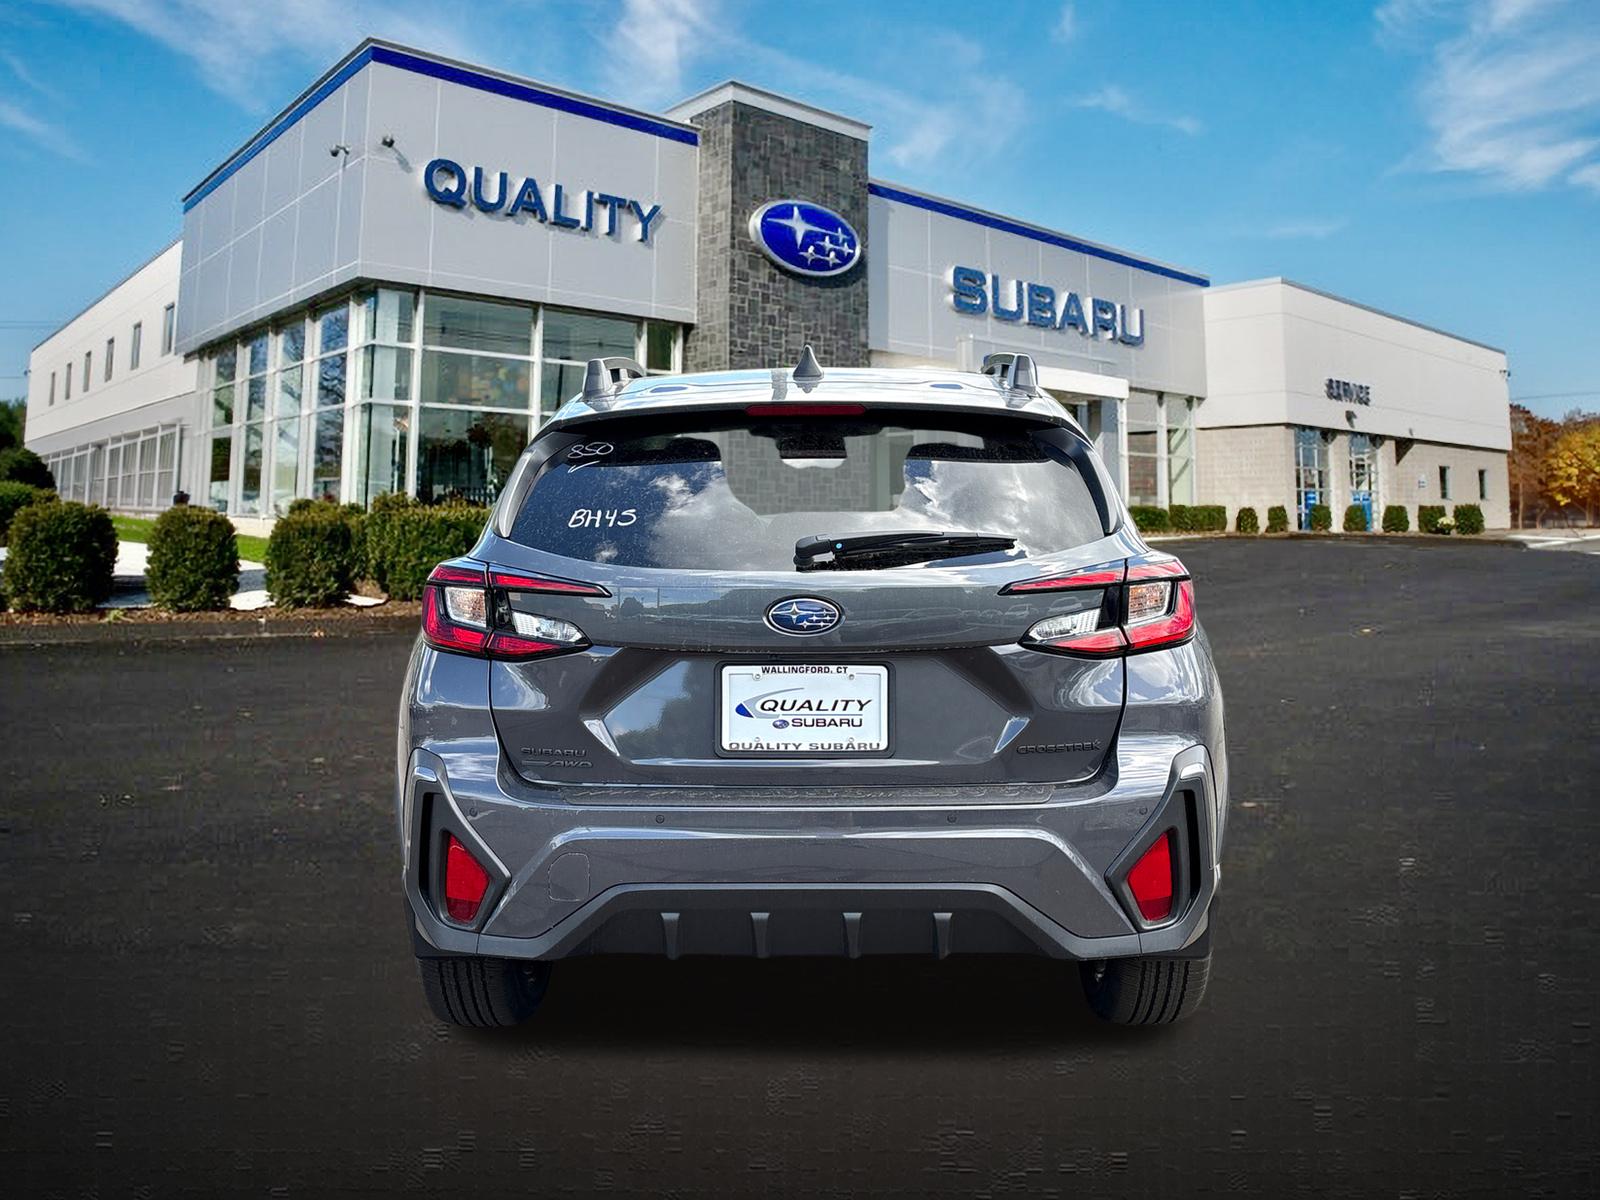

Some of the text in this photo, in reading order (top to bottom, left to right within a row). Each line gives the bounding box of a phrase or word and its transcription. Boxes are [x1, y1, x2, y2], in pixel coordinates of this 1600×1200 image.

[424, 158, 661, 242] QUALITY
[952, 265, 1145, 346] SUBARU
[836, 666, 848, 674] CT
[760, 699, 873, 712] QUALITY
[791, 718, 863, 728] SUBARU
[729, 742, 881, 751] QUALITY SUBARU
[1016, 739, 1101, 754] CROSSTREK
[520, 747, 587, 757] SUBARU
[545, 760, 593, 768] AWD
